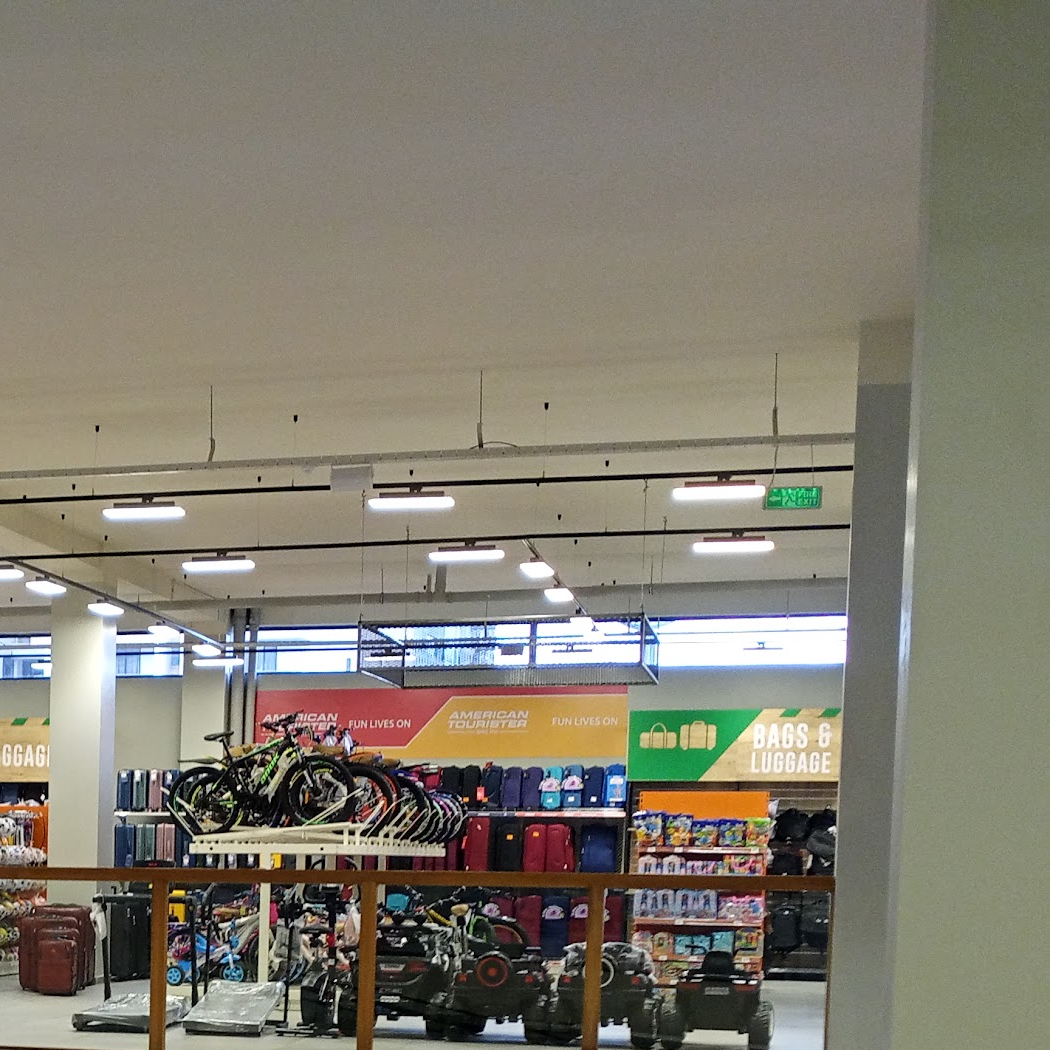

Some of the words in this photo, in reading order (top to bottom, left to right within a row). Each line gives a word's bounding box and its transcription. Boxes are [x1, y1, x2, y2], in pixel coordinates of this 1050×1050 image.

[262, 713, 338, 722] AMRICAN
[449, 710, 529, 720] AMERICAN
[348, 719, 367, 729] FUN
[369, 719, 394, 729] LIVES
[396, 718, 411, 728] ON
[447, 719, 527, 729] TOURISTER
[552, 716, 572, 726] FUN
[574, 717, 600, 726] LIVES
[602, 716, 618, 726] ON
[753, 722, 809, 750] BAGS
[818, 722, 833, 748] &
[751, 751, 832, 774] LUGGAGE
